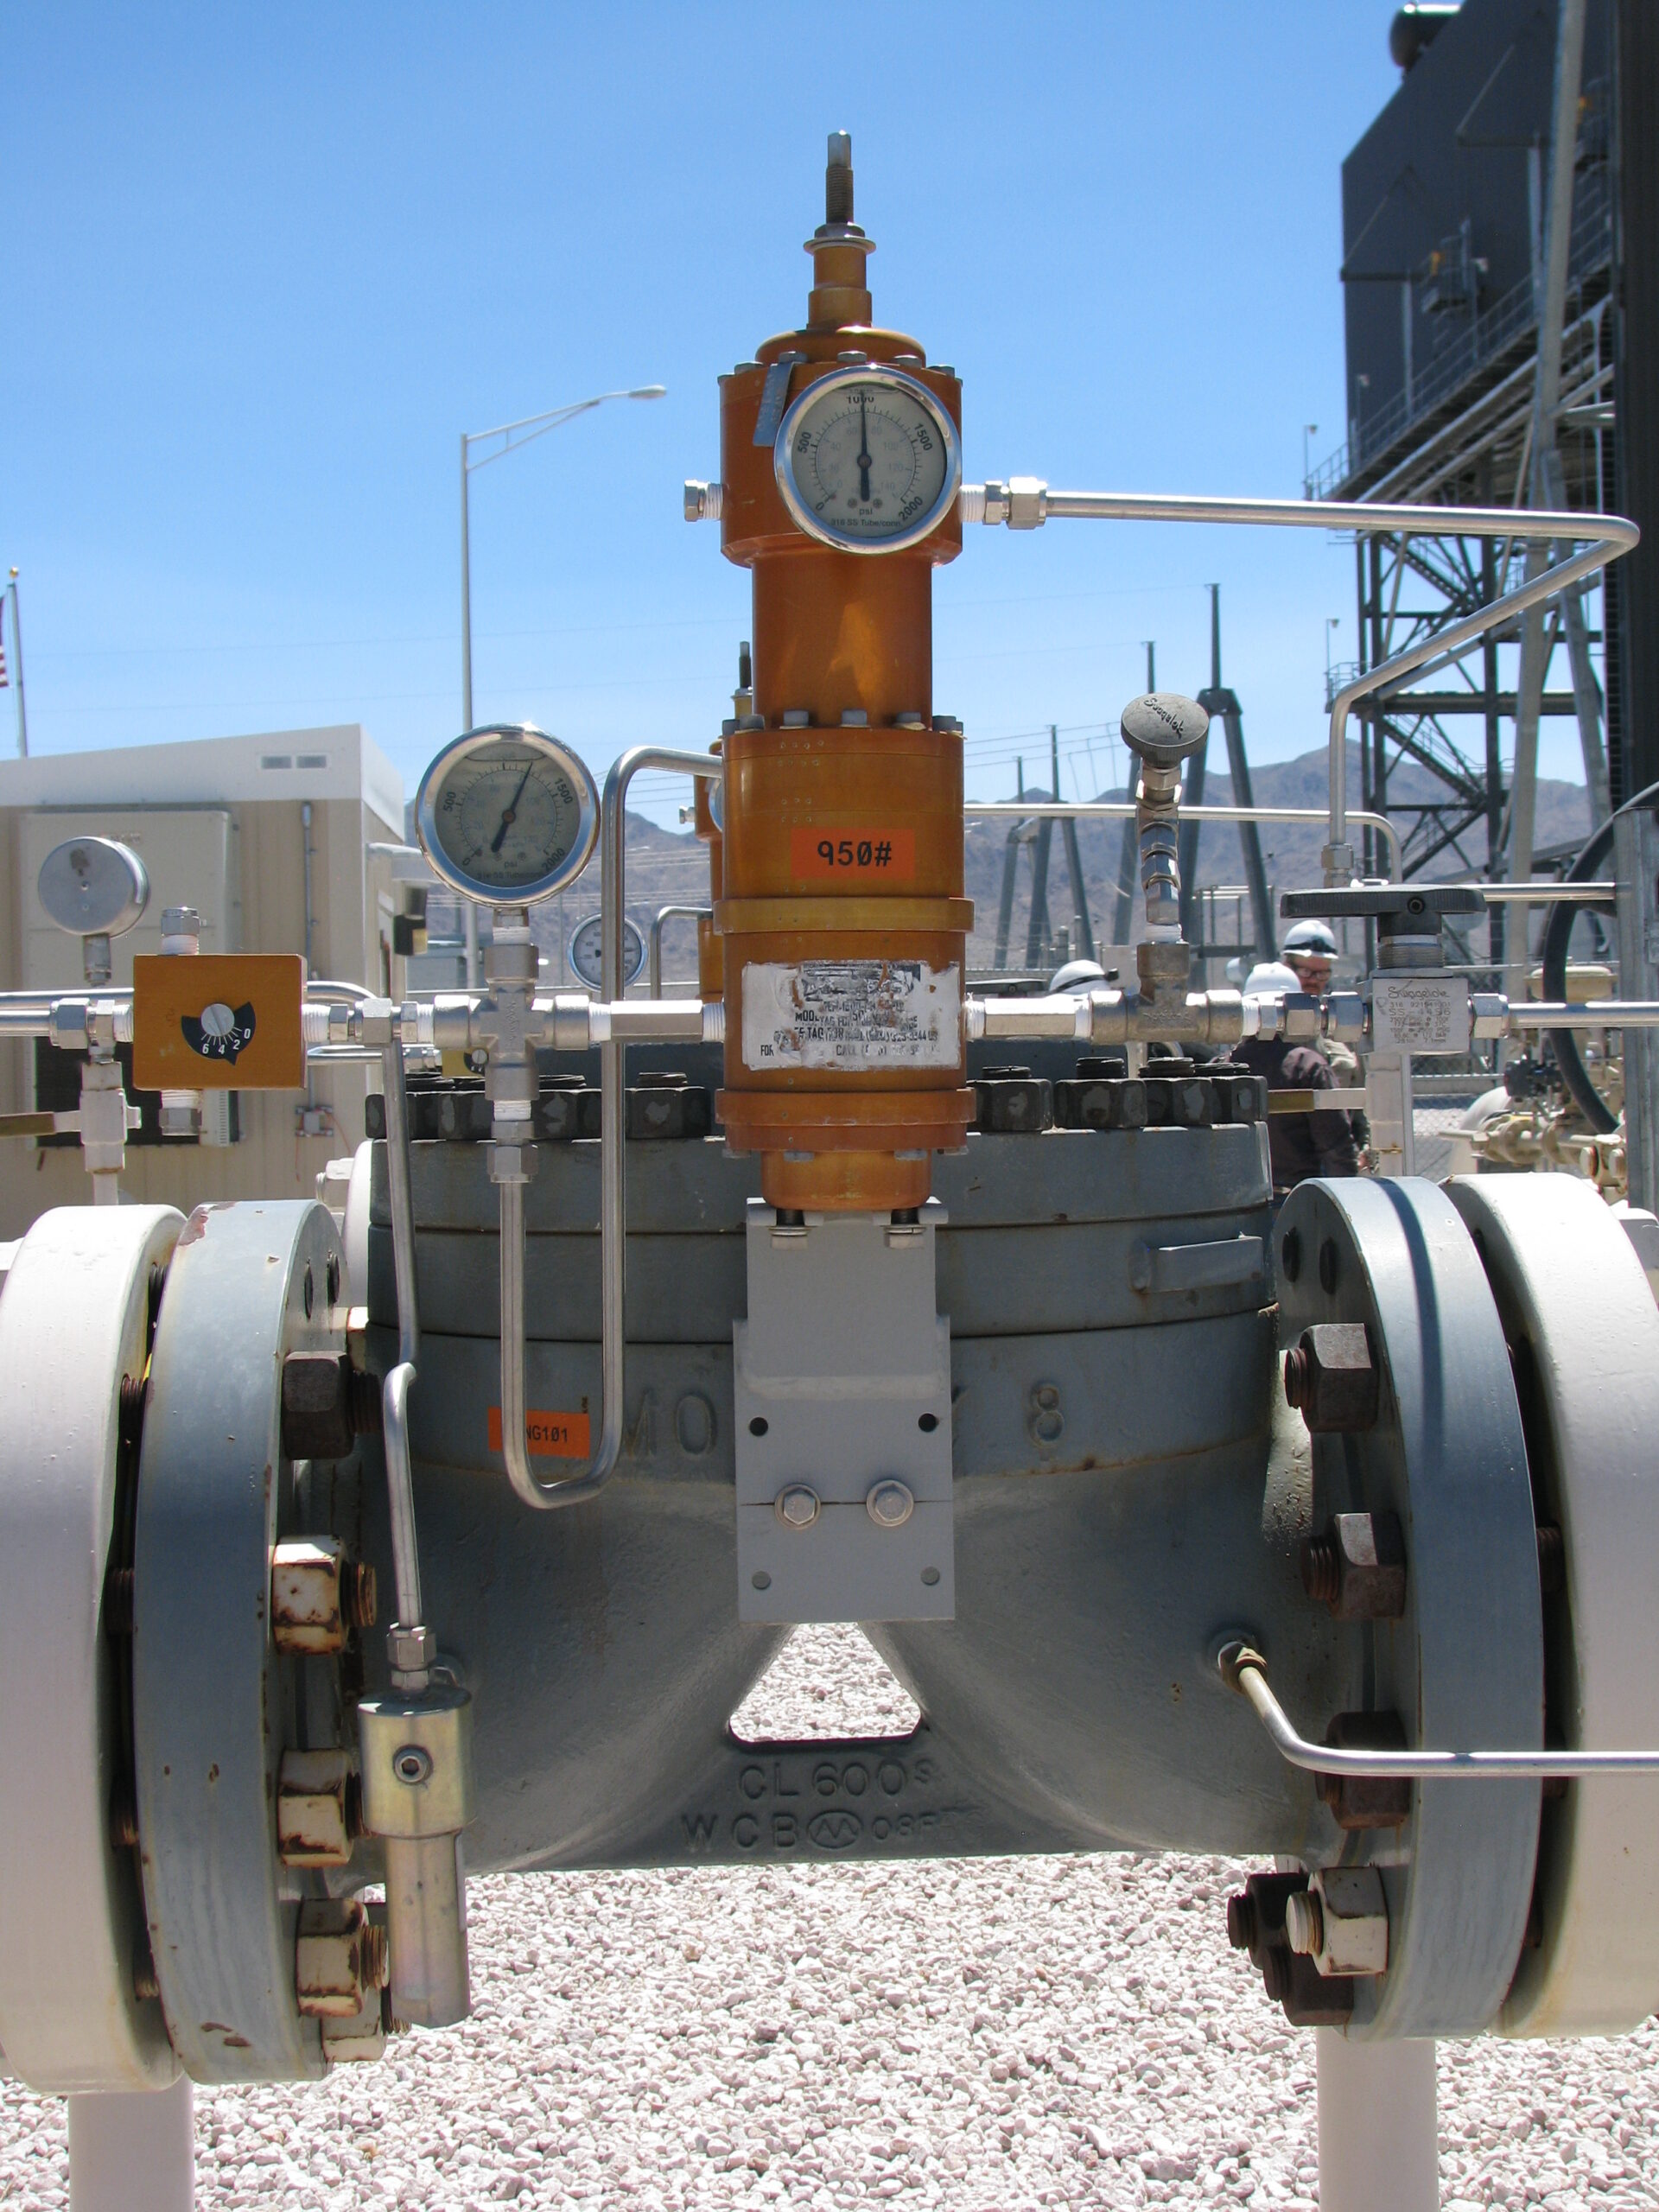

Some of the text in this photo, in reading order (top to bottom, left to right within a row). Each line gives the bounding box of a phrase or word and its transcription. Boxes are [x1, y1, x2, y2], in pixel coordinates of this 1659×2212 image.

[798, 431, 811, 454] 500
[914, 423, 933, 451] 1500
[815, 501, 825, 512] 0
[859, 507, 873, 516] psi
[899, 496, 924, 521] 2000
[443, 791, 457, 813] 500
[554, 778, 574, 804] 1500
[461, 857, 472, 867] 0
[541, 848, 565, 872] 2000
[817, 840, 892, 868] 950#
[202, 1028, 251, 1055] 6 4 2 0
[1028, 1380, 1065, 1449] 8
